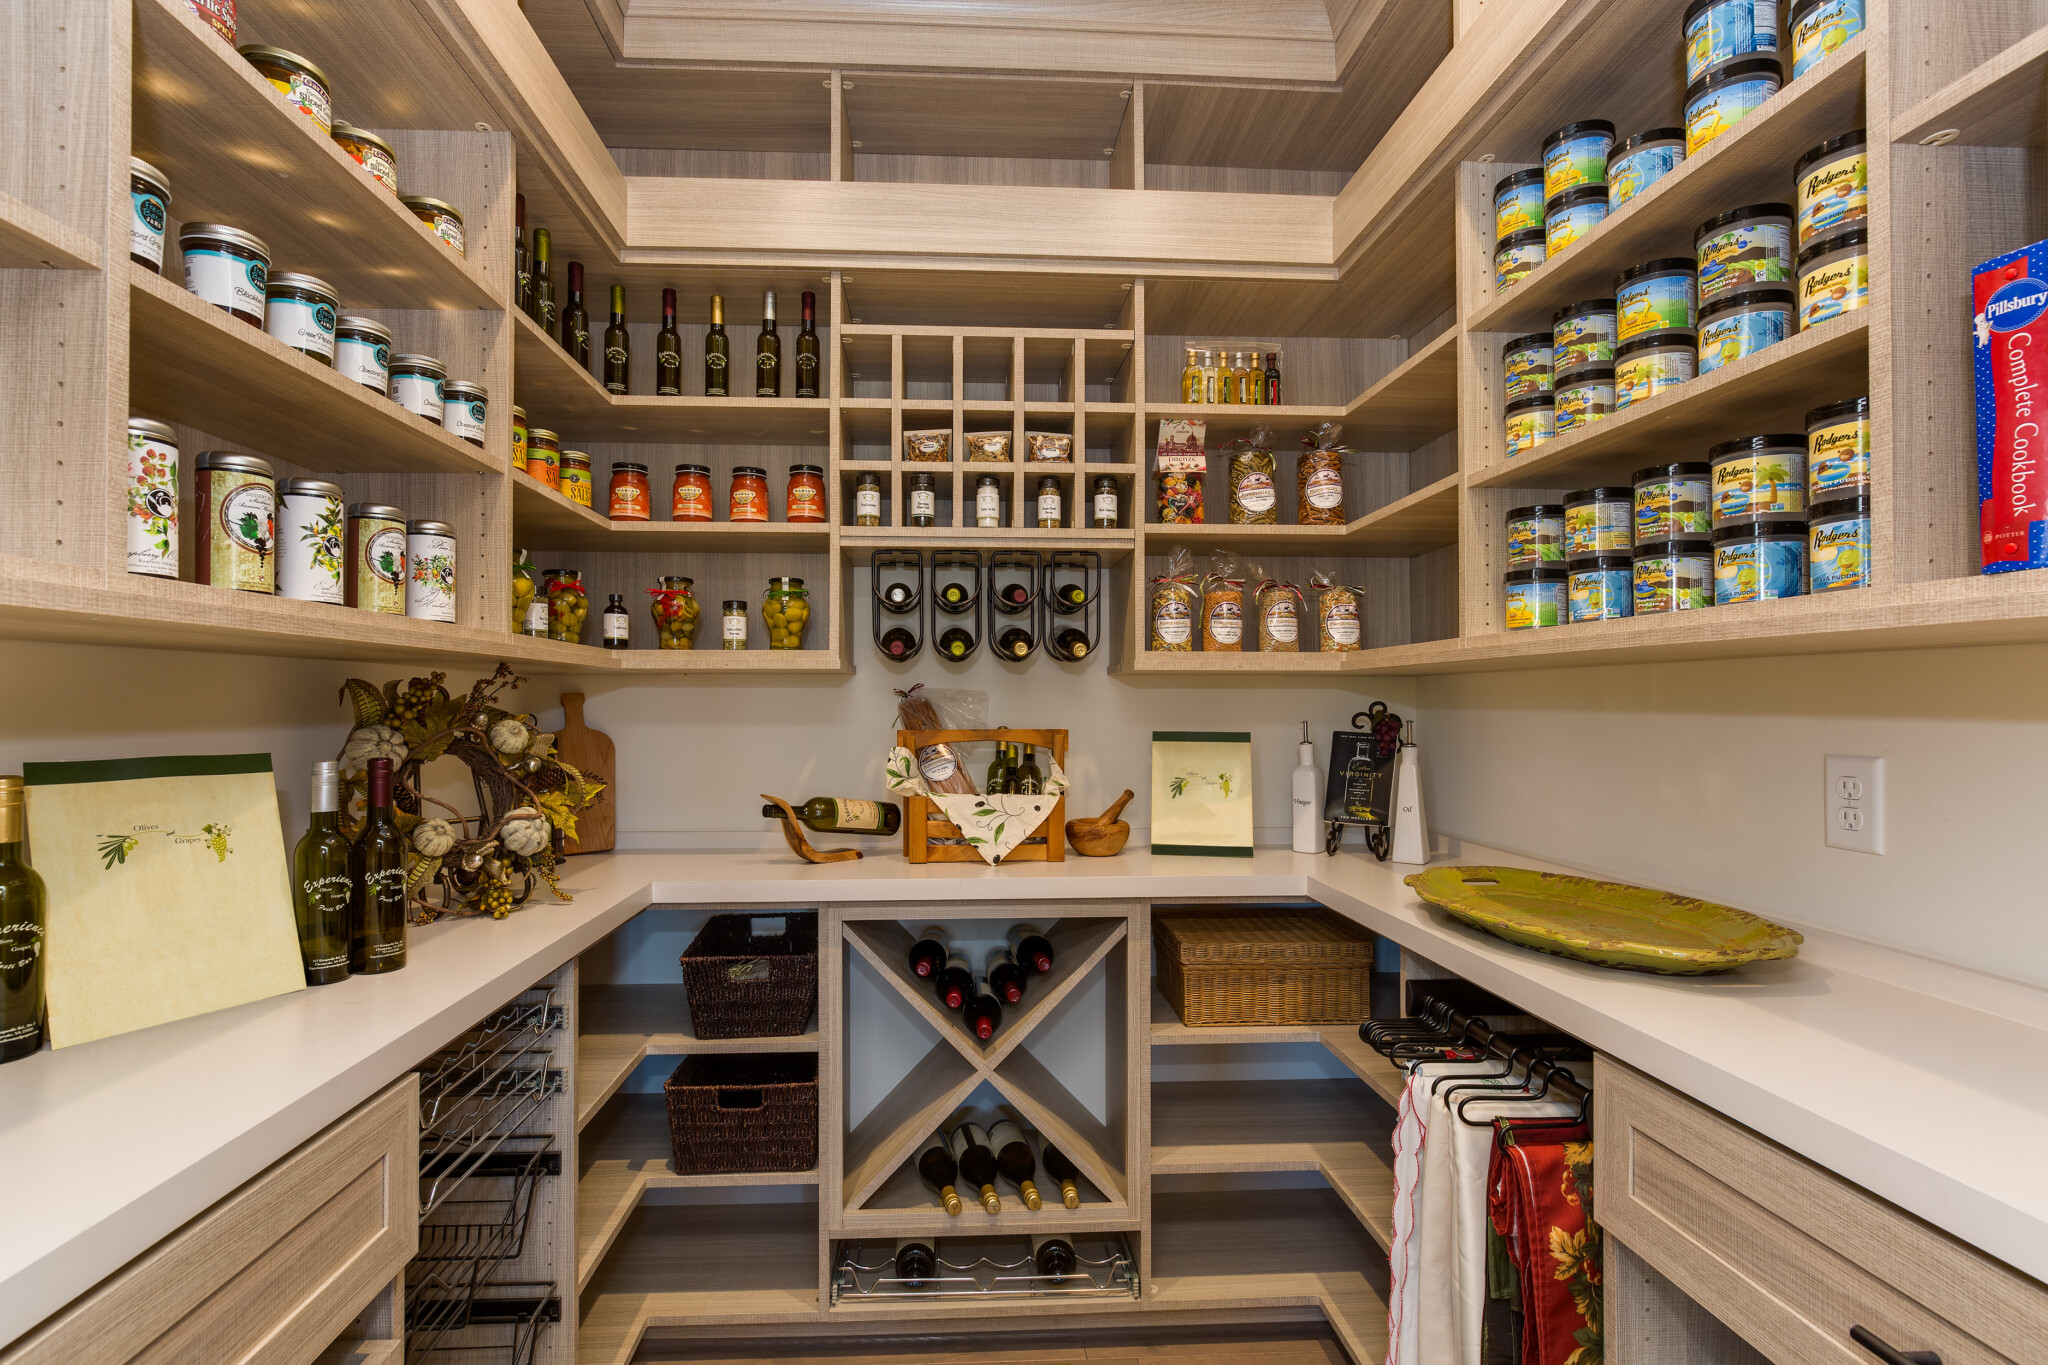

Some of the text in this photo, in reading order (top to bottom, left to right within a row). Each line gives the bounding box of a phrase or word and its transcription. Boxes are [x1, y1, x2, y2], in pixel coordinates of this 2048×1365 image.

[211, 18, 233, 40] SPICY
[299, 92, 323, 111] Sliced
[370, 162, 390, 178] Sliced
[1987, 291, 2048, 319] Pillsbury
[297, 328, 317, 339] Green
[2008, 332, 2039, 517] Complete Cookbook
[1995, 531, 2025, 540] POTTER
[1339, 771, 1383, 779] VIRGINITY
[1403, 805, 1414, 813] Oil
[133, 824, 159, 832] Olives
[174, 837, 202, 845] Grapes
